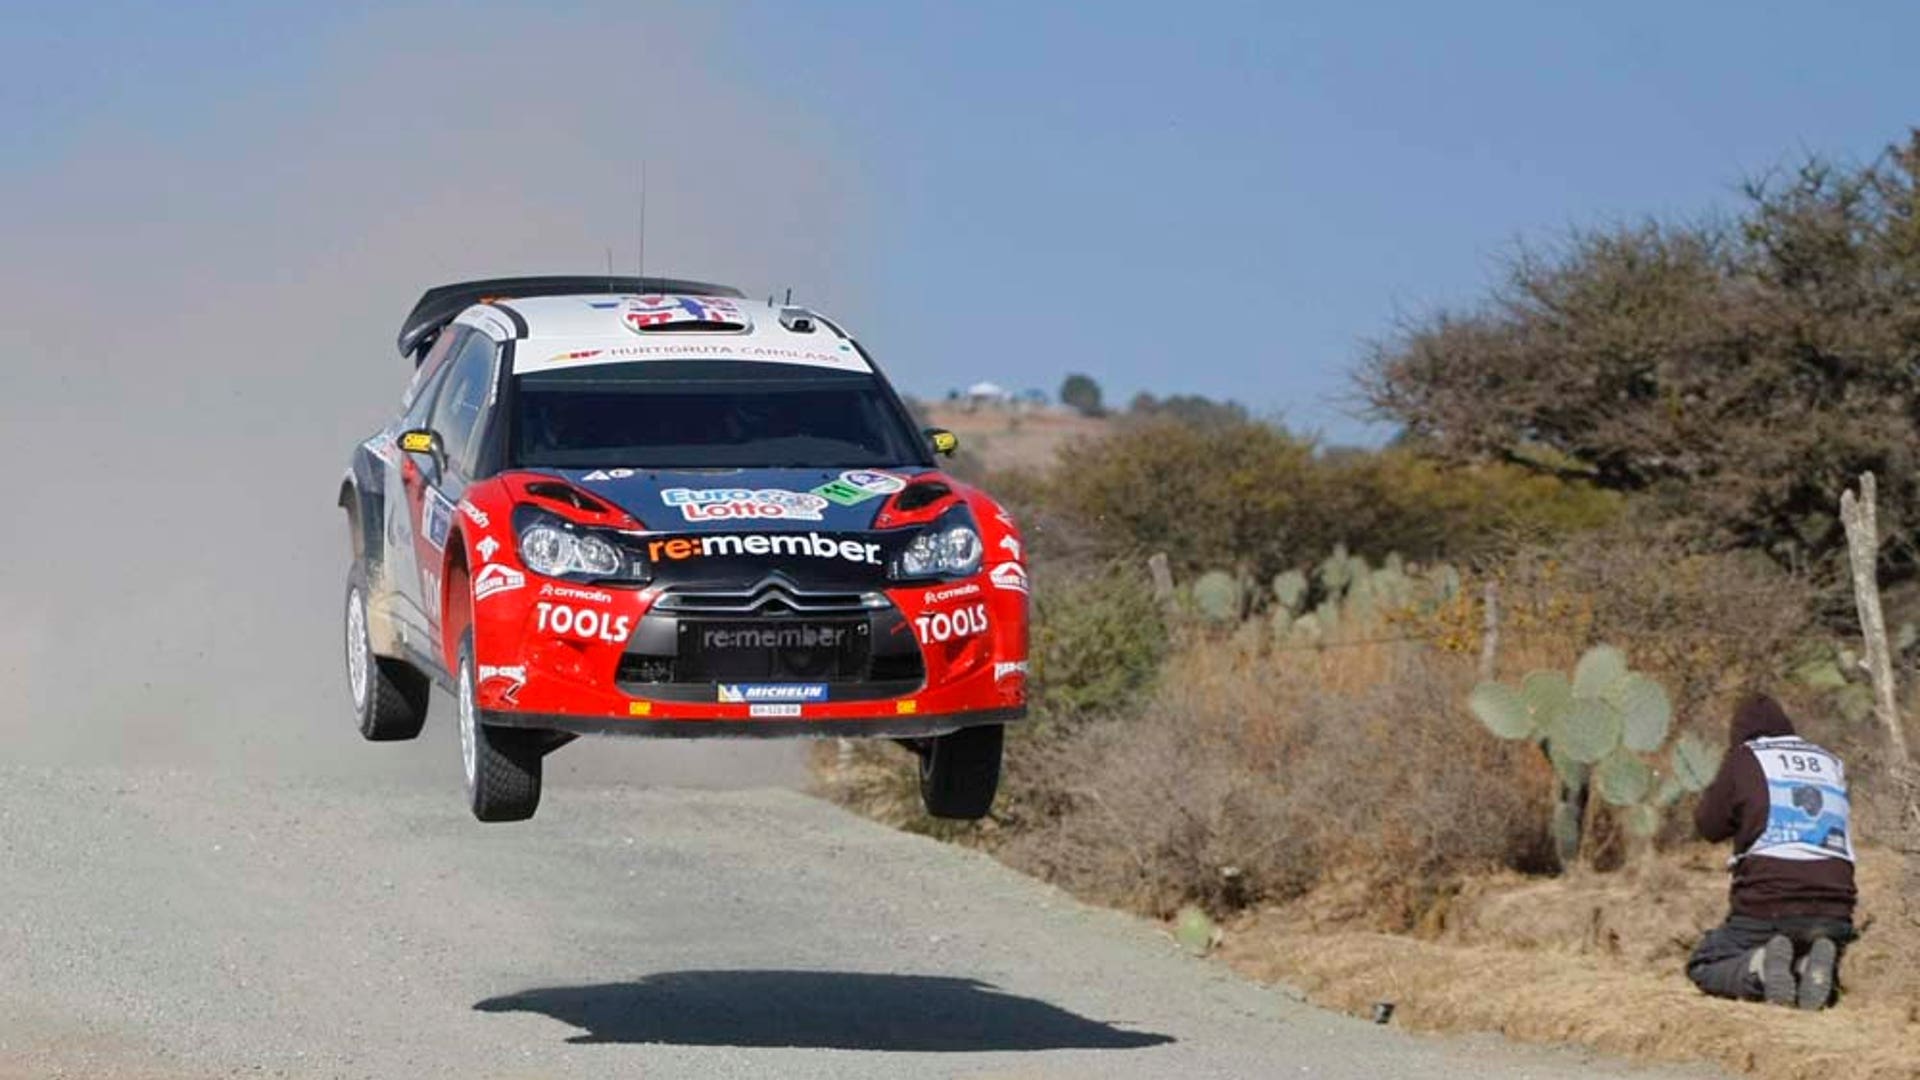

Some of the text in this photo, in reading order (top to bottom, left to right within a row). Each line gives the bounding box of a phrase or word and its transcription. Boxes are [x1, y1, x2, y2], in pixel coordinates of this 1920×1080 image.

[663, 490, 752, 504] Euro
[684, 502, 783, 518] Lotto
[648, 532, 882, 565] re:member
[537, 602, 629, 642] TOOLS
[915, 604, 987, 644] TOOLS
[703, 624, 845, 648] re:member
[744, 685, 823, 698] MICHELIN
[1778, 753, 1822, 773] 198
